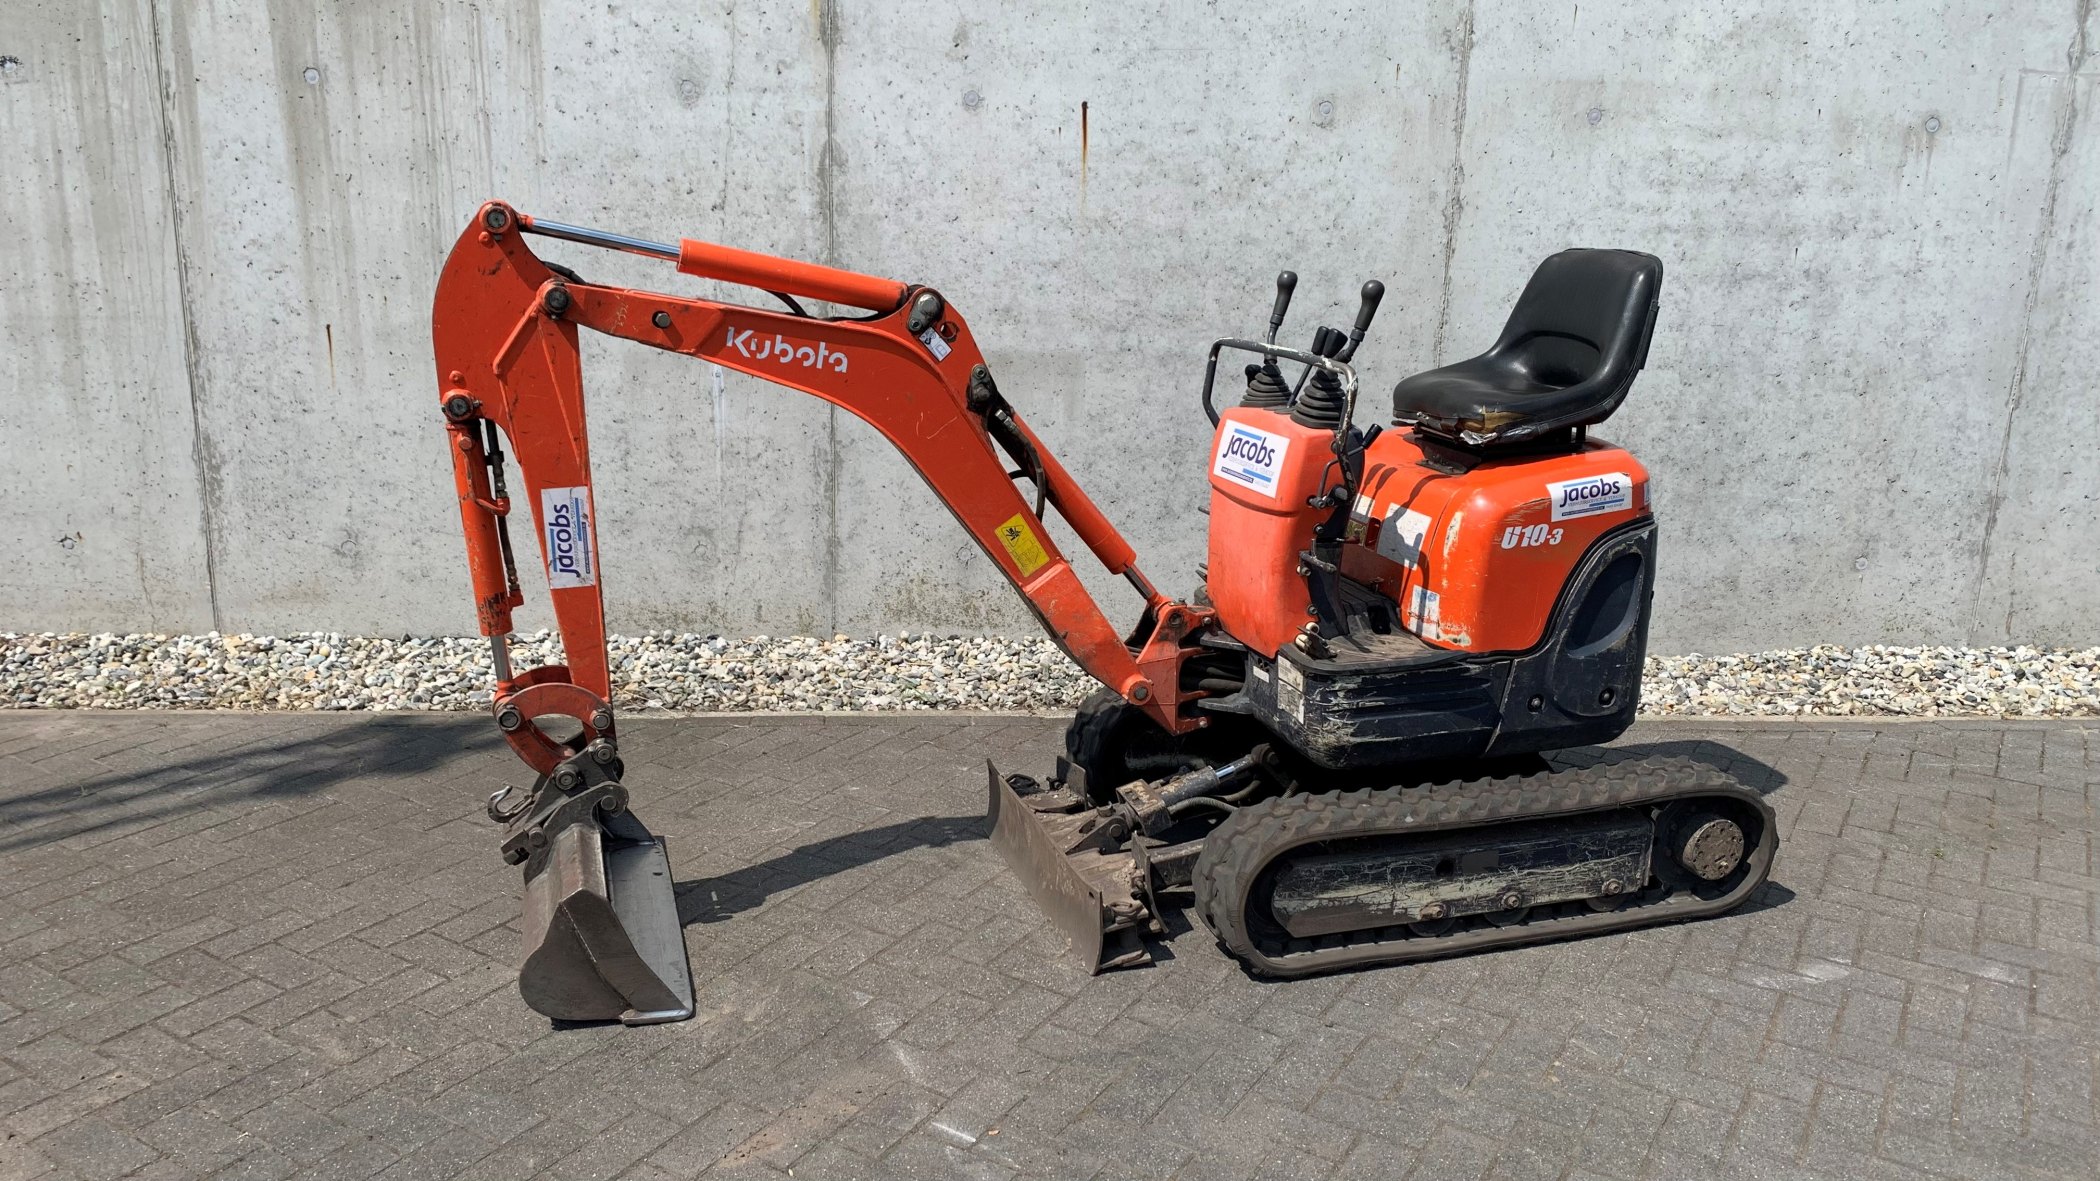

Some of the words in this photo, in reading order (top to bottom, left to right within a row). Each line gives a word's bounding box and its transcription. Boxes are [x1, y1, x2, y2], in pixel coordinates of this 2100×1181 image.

[726, 326, 848, 373] Kubota
[1222, 434, 1276, 468] jacobs
[1559, 477, 1621, 508] jacobs
[548, 503, 581, 578] jacobs
[1500, 523, 1564, 550] U10-3
